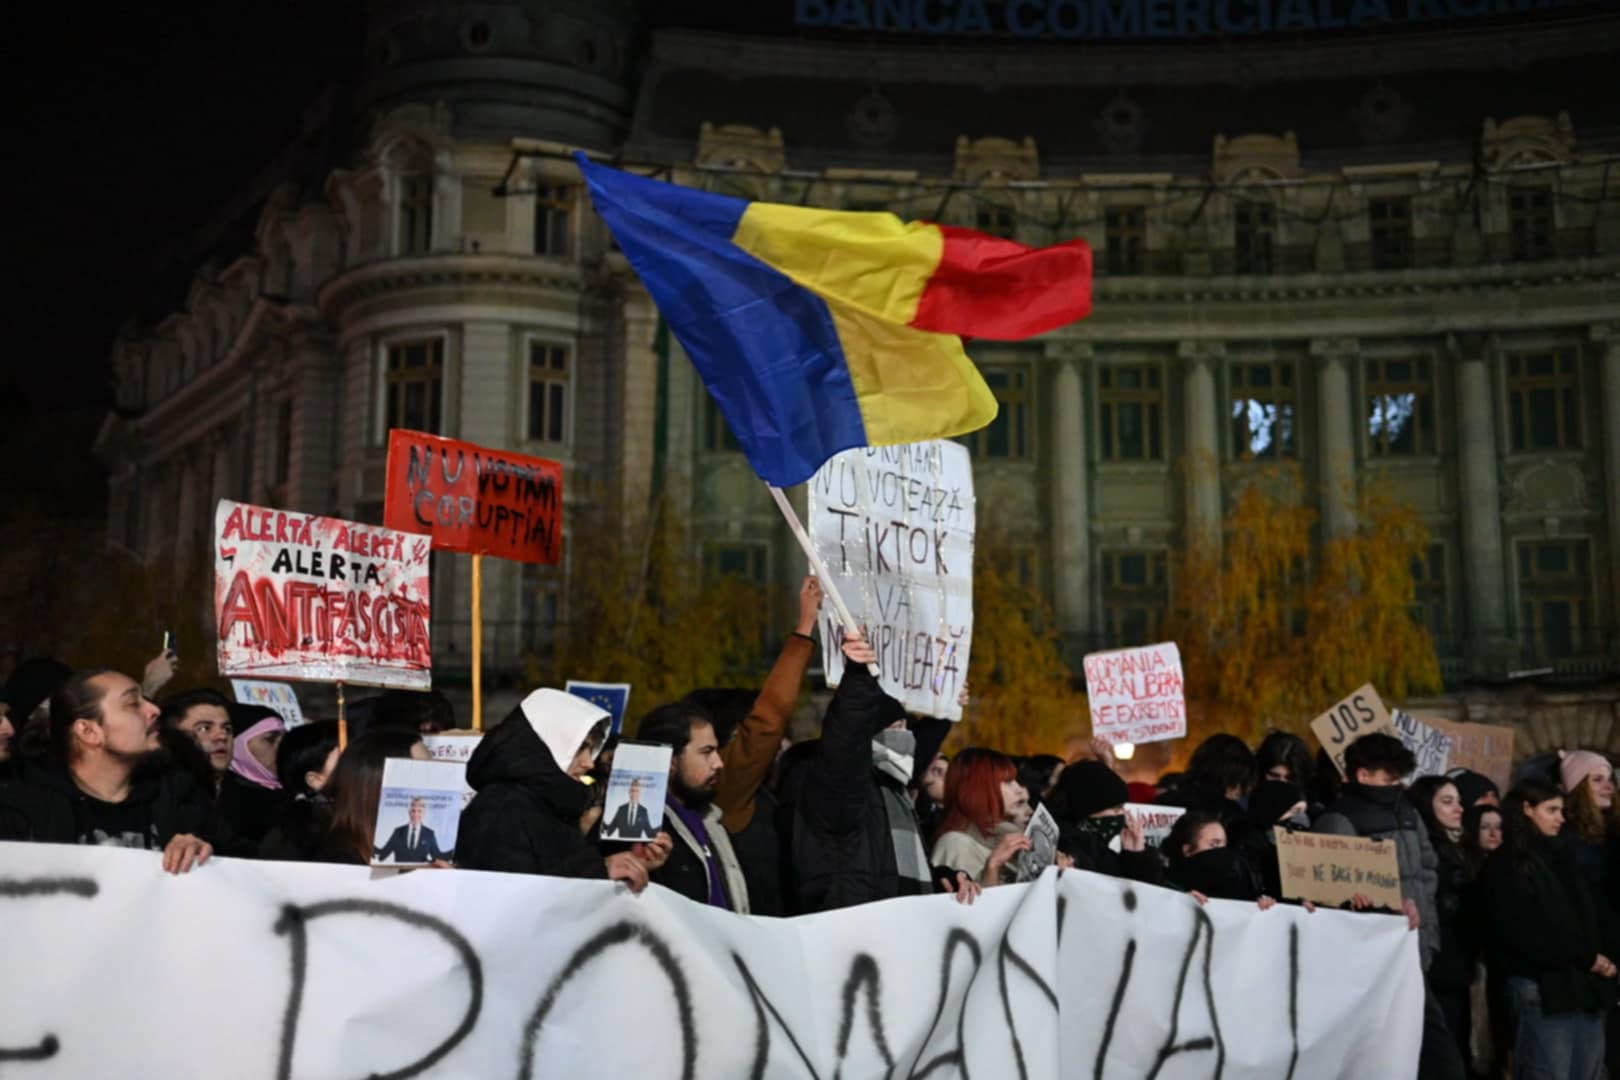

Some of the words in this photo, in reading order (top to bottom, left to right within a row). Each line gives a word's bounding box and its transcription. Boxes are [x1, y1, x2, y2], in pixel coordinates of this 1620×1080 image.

[407, 444, 464, 490] NU
[271, 547, 381, 585] ALERTA
[1329, 695, 1376, 744] JOS
[1394, 711, 1419, 737] NU
